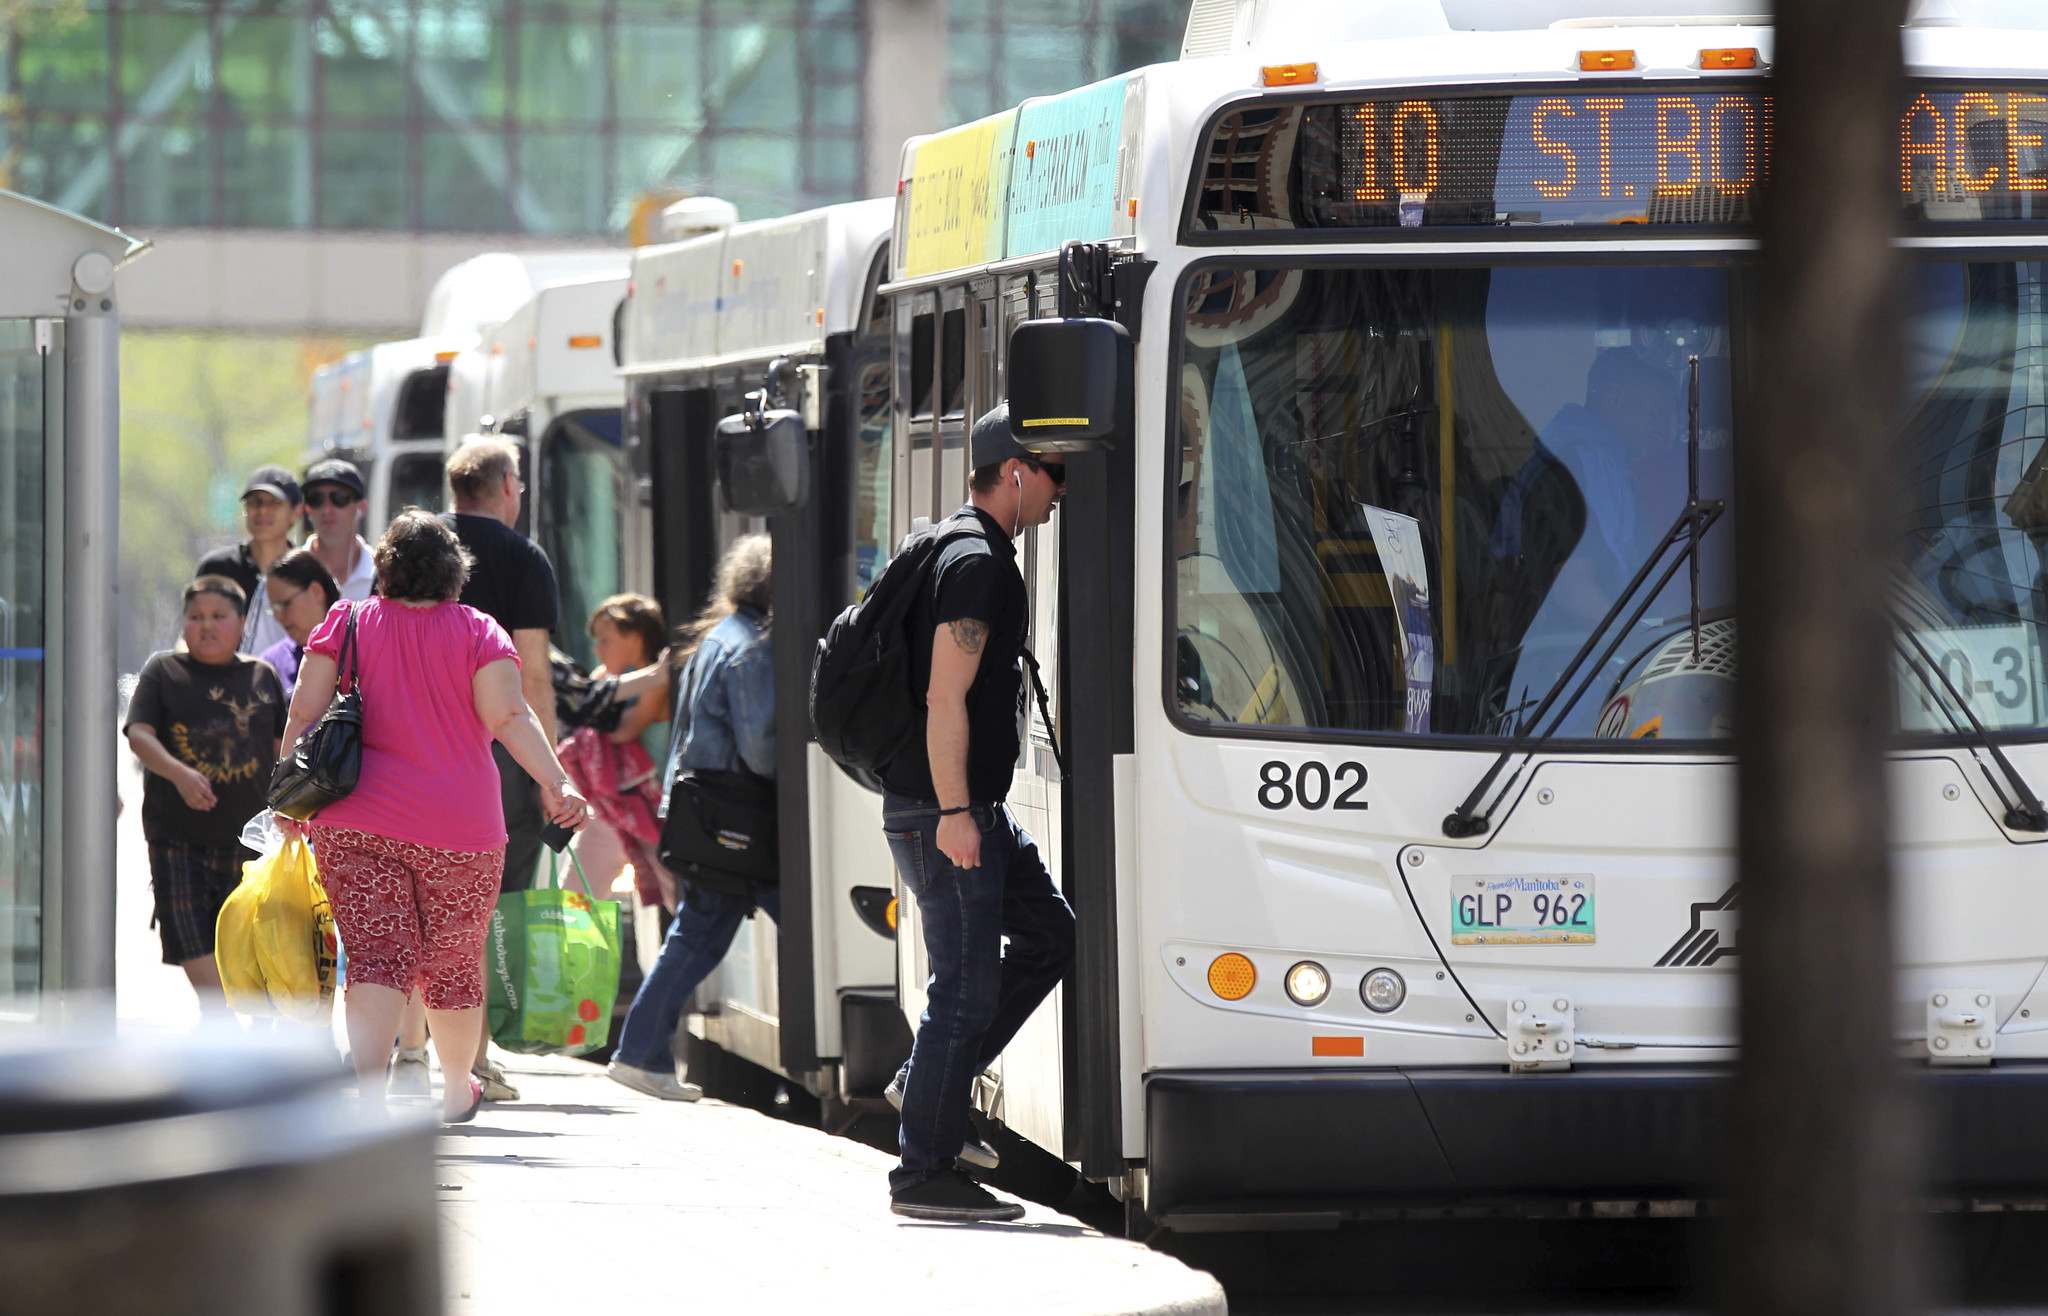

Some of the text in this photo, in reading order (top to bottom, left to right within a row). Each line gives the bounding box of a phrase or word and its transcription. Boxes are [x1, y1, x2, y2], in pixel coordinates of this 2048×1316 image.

[1355, 101, 1438, 199] 10
[1257, 760, 1369, 810] 802
[1514, 878, 1560, 892] Manitoba
[1459, 893, 1588, 926] GLP 962
